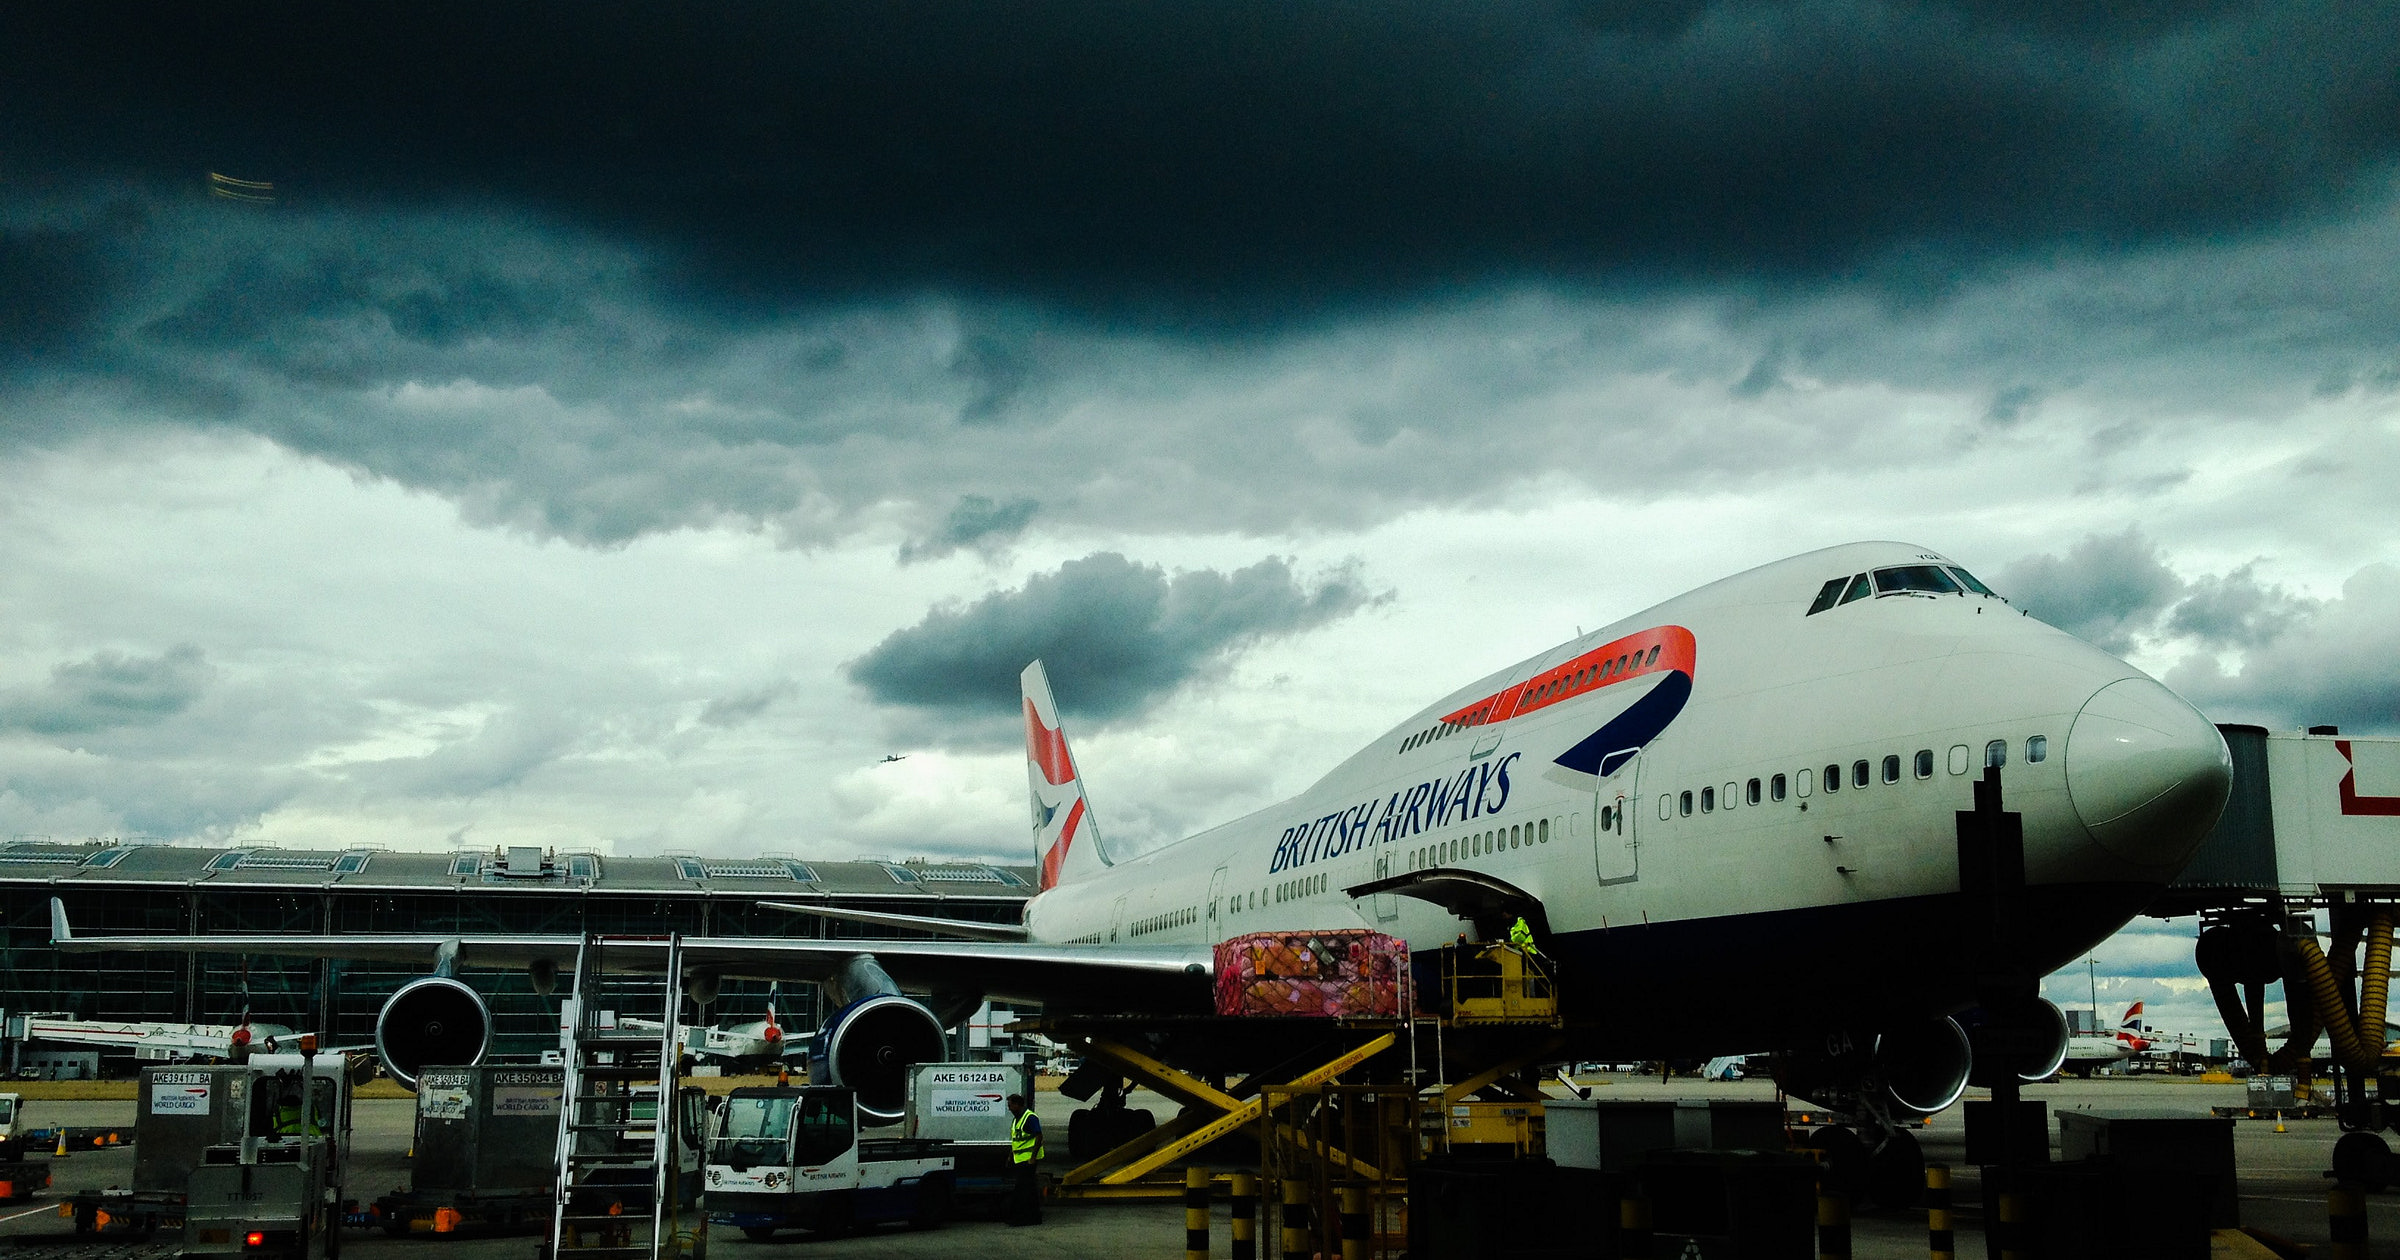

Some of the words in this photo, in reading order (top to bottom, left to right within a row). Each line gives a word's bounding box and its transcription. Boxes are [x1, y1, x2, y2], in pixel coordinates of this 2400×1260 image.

[1269, 799, 1379, 874] BRITISH
[1369, 752, 1521, 847] AIRWAYS
[1826, 1031, 1854, 1056] GA
[199, 1073, 210, 1083] BA
[495, 1073, 515, 1083] AKE
[517, 1073, 550, 1083] 35034
[552, 1073, 565, 1083] BA
[934, 1073, 955, 1082] AKE
[959, 1073, 987, 1082] 16124
[989, 1073, 1004, 1082] BA
[496, 1103, 523, 1111] WORLD
[524, 1103, 549, 1111] CARGO
